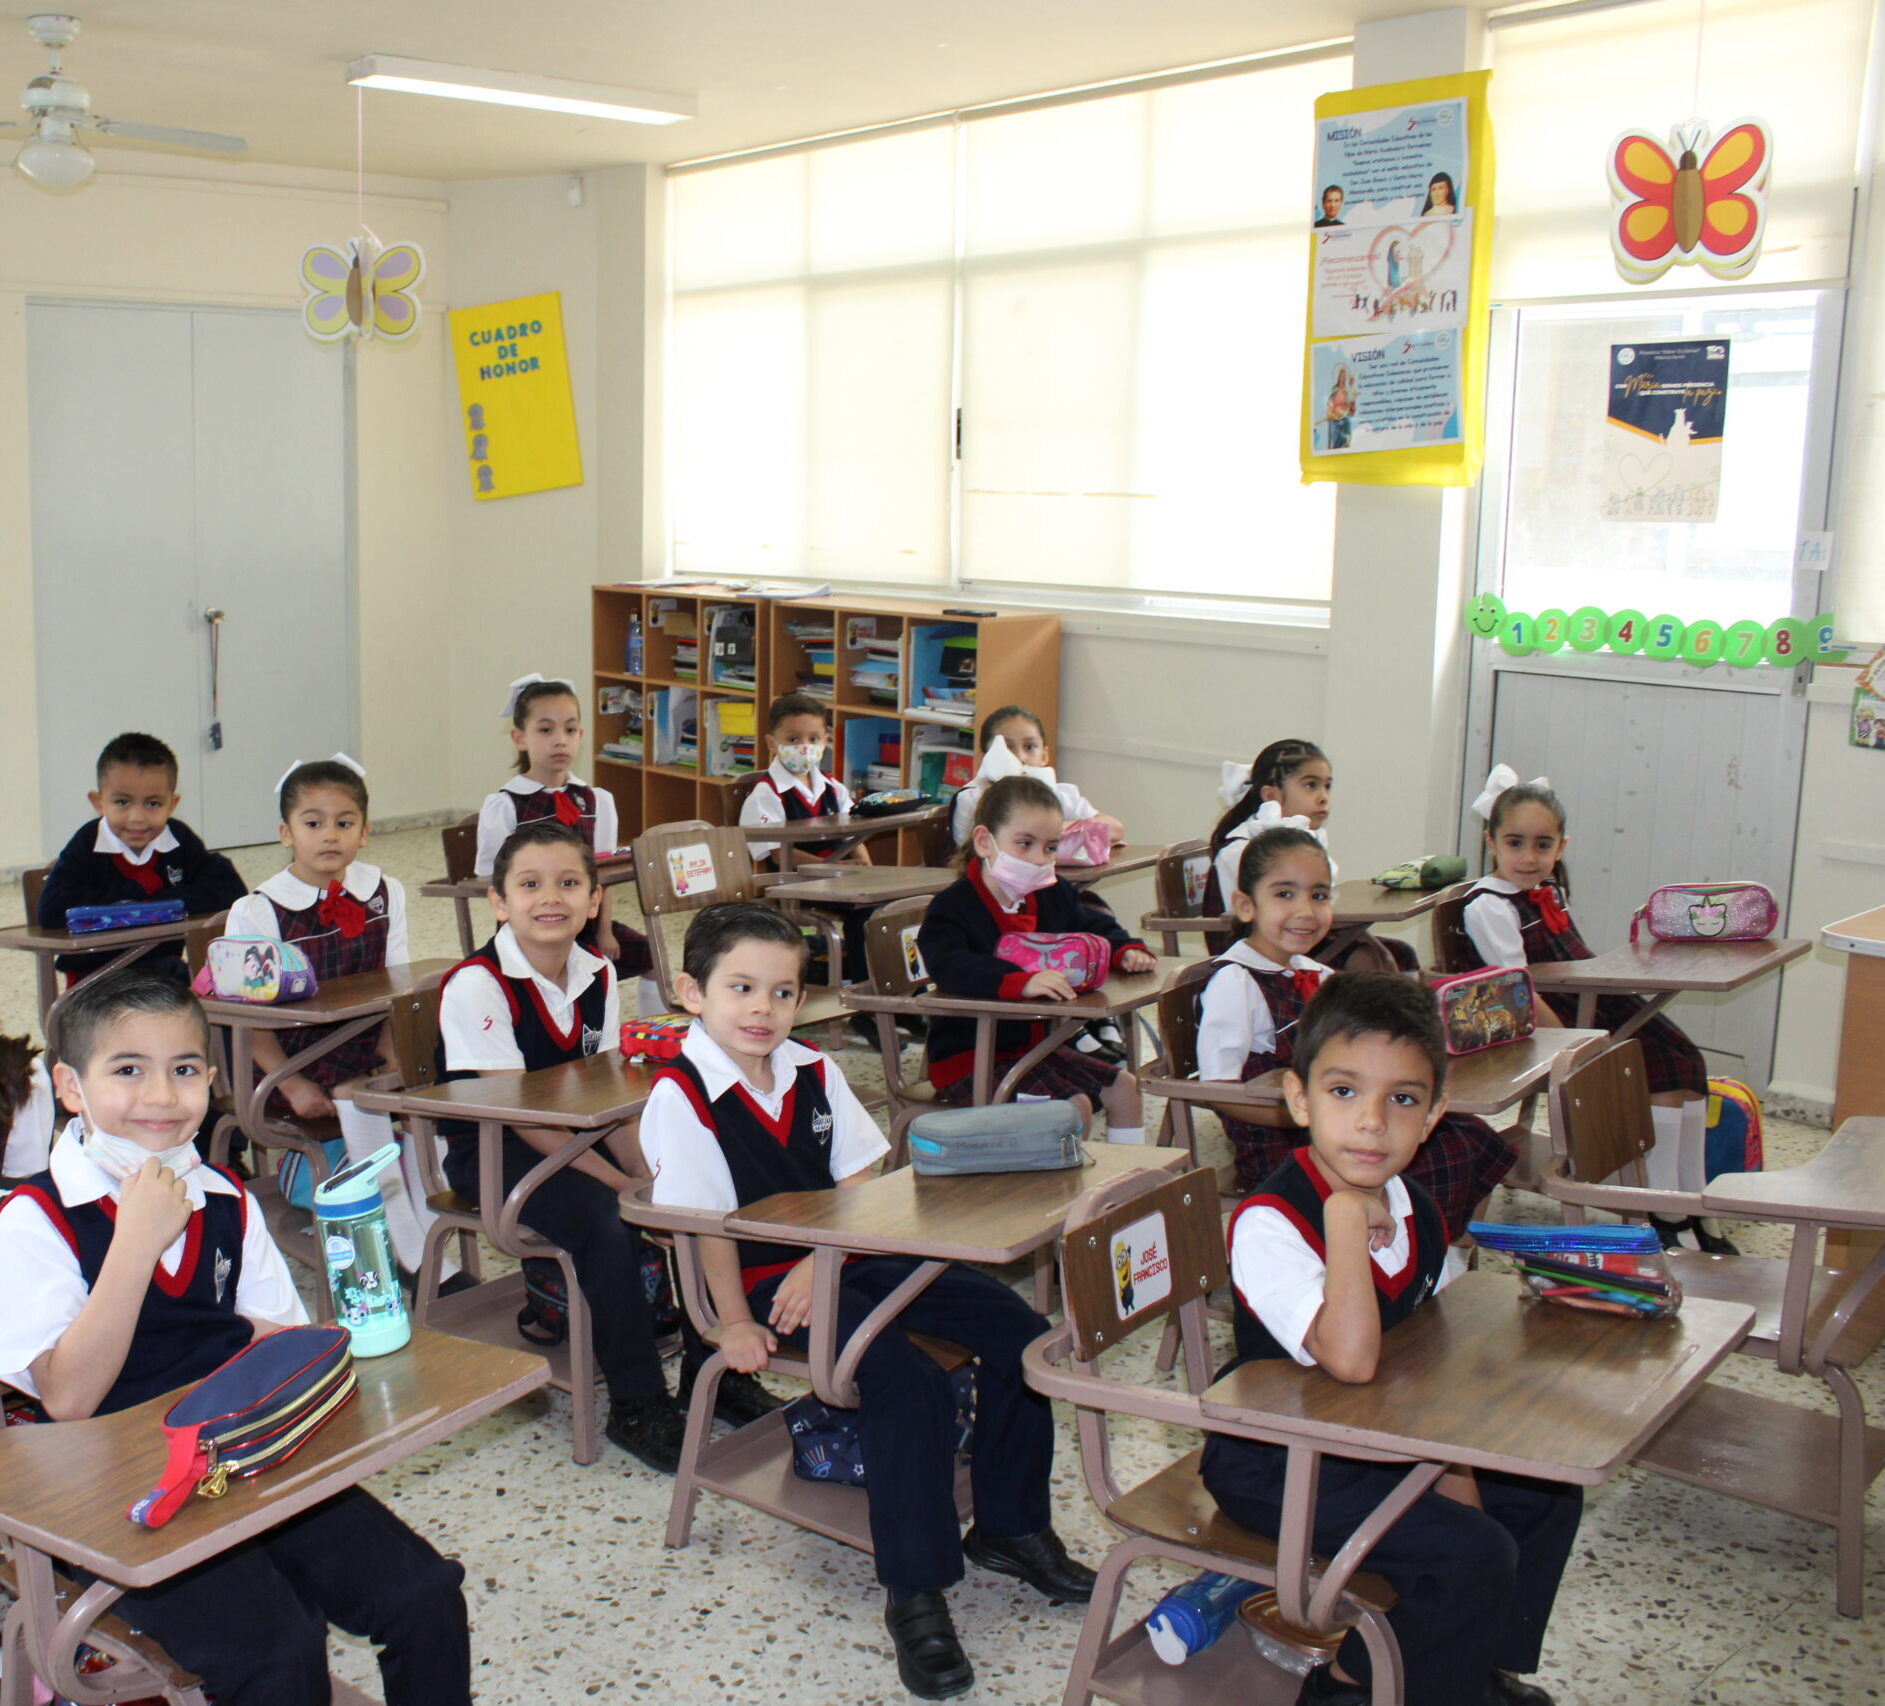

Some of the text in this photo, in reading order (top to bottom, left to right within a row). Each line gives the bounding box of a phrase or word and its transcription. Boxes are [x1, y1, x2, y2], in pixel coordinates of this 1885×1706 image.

[1327, 127, 1362, 141] MISIÓN
[469, 320, 542, 347] CUADRO
[497, 343, 518, 360] DE
[1351, 349, 1385, 362] VISIÓN
[480, 356, 540, 381] HONOR
[1511, 621, 1523, 645] 1
[1545, 618, 1559, 640] 2
[1579, 618, 1595, 641] 3
[1617, 620, 1634, 643] 4
[1656, 624, 1674, 648] 5
[1694, 629, 1712, 653] 6
[1737, 632, 1754, 656] 7
[1775, 630, 1792, 655] 8
[1140, 1240, 1157, 1265] JOSÉ
[1133, 1258, 1168, 1286] FRANCISCO
